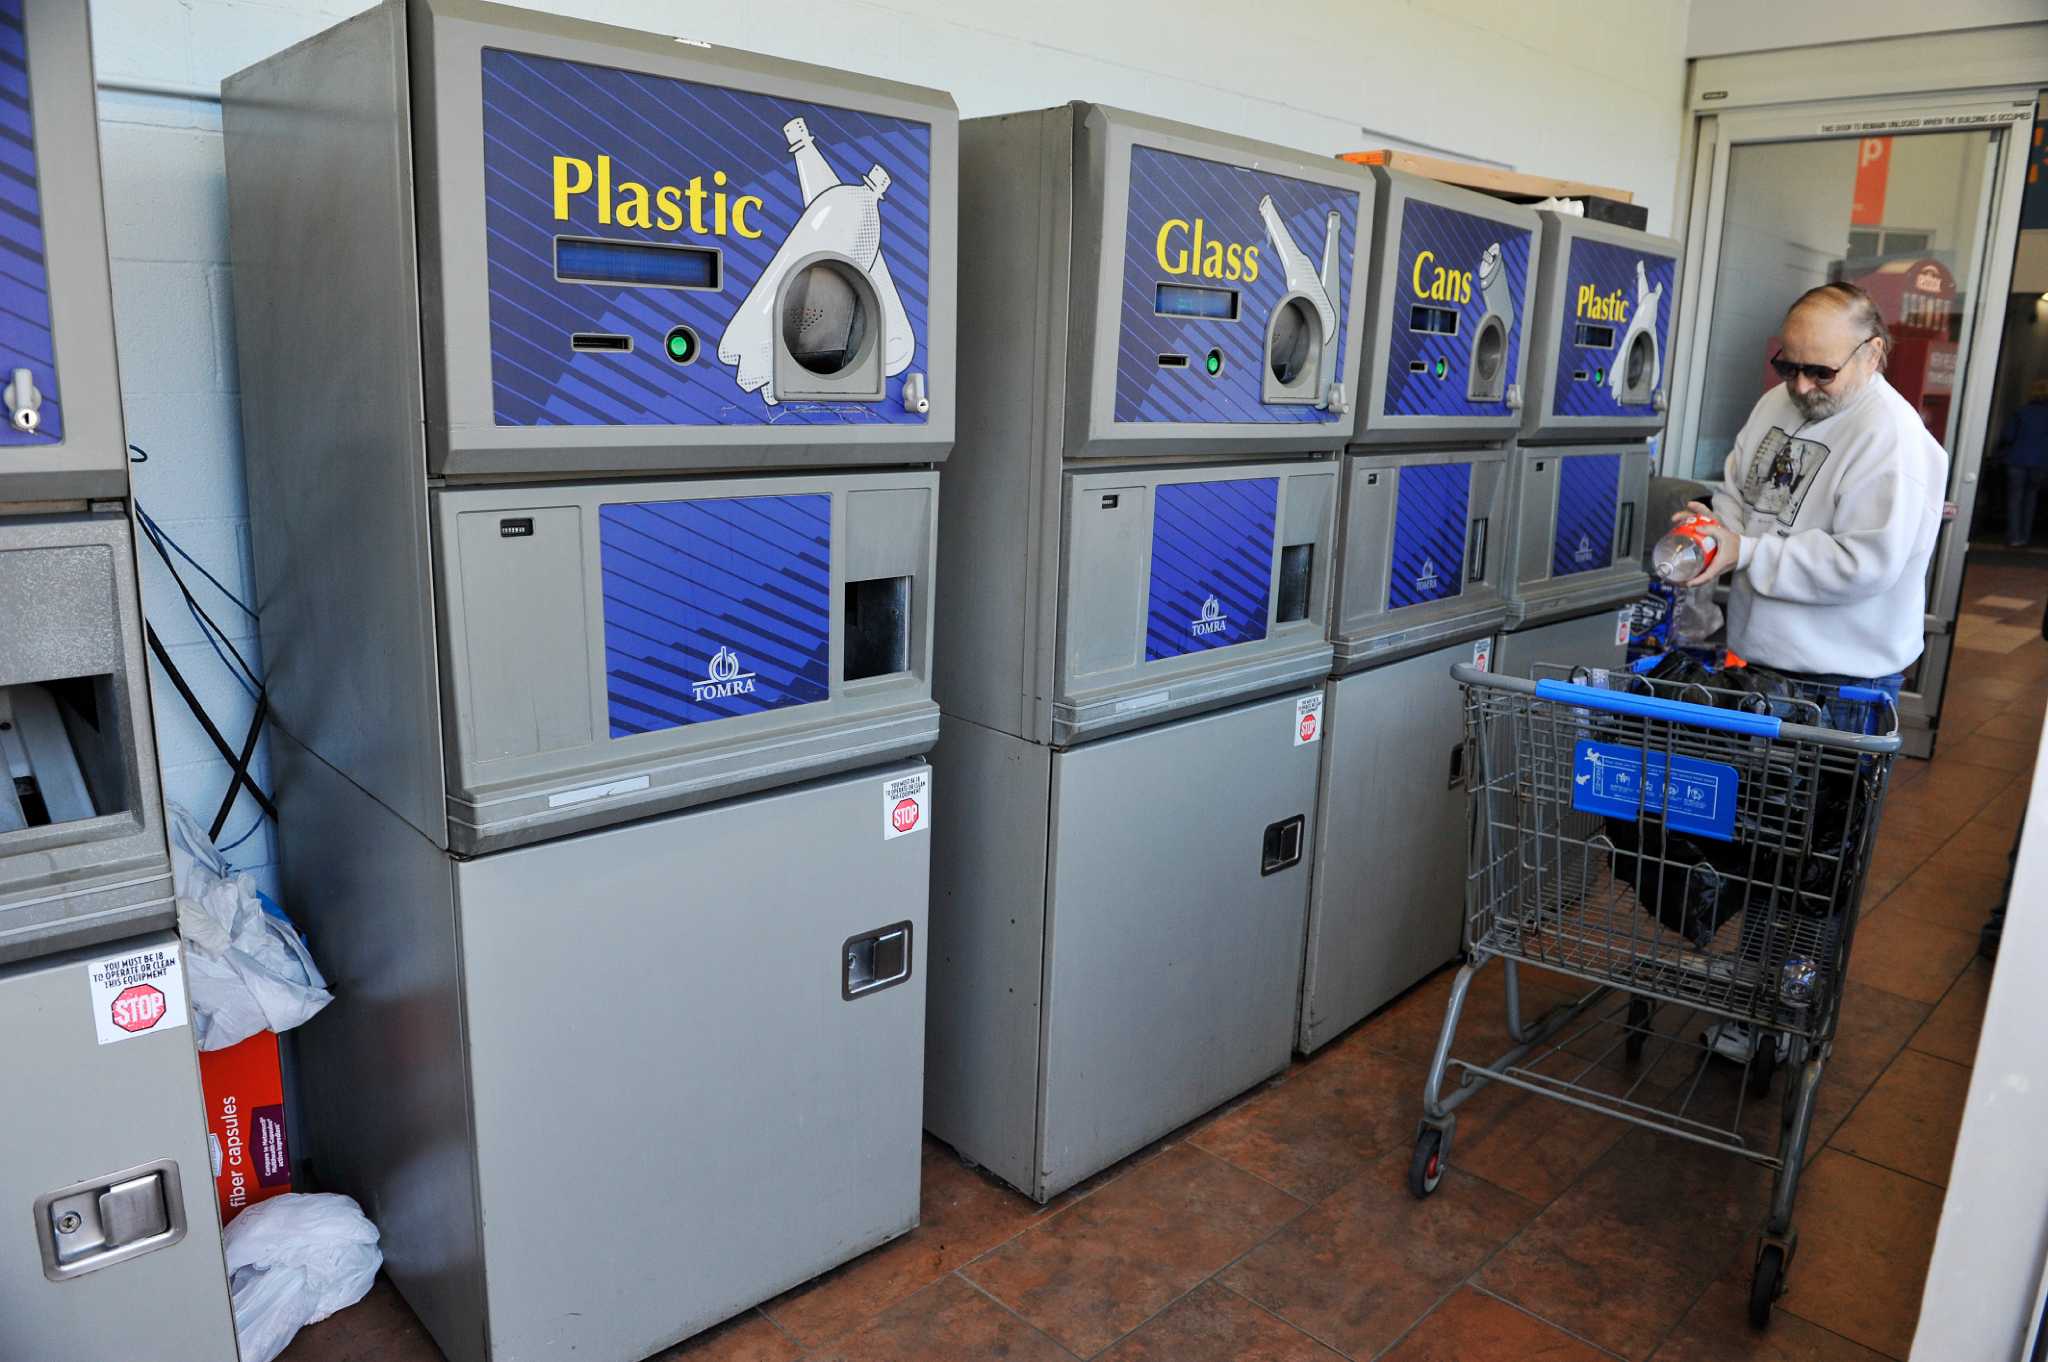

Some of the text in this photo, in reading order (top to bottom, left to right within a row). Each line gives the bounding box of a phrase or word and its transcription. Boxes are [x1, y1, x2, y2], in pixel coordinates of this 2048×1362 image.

[552, 154, 764, 240] Plastic
[1156, 217, 1260, 282] Glass
[1412, 250, 1473, 305] Cans
[1576, 283, 1630, 323] Plastic
[1192, 620, 1226, 636] TOMRA
[894, 804, 918, 827] STOP
[93, 958, 176, 982] TO OPERATE OR CLEAN
[104, 952, 164, 971] YOU MUST BE 18
[104, 968, 167, 989] THIS EQUIPMENT
[114, 992, 164, 1026] STOP
[221, 1096, 247, 1207] fiber capsules
